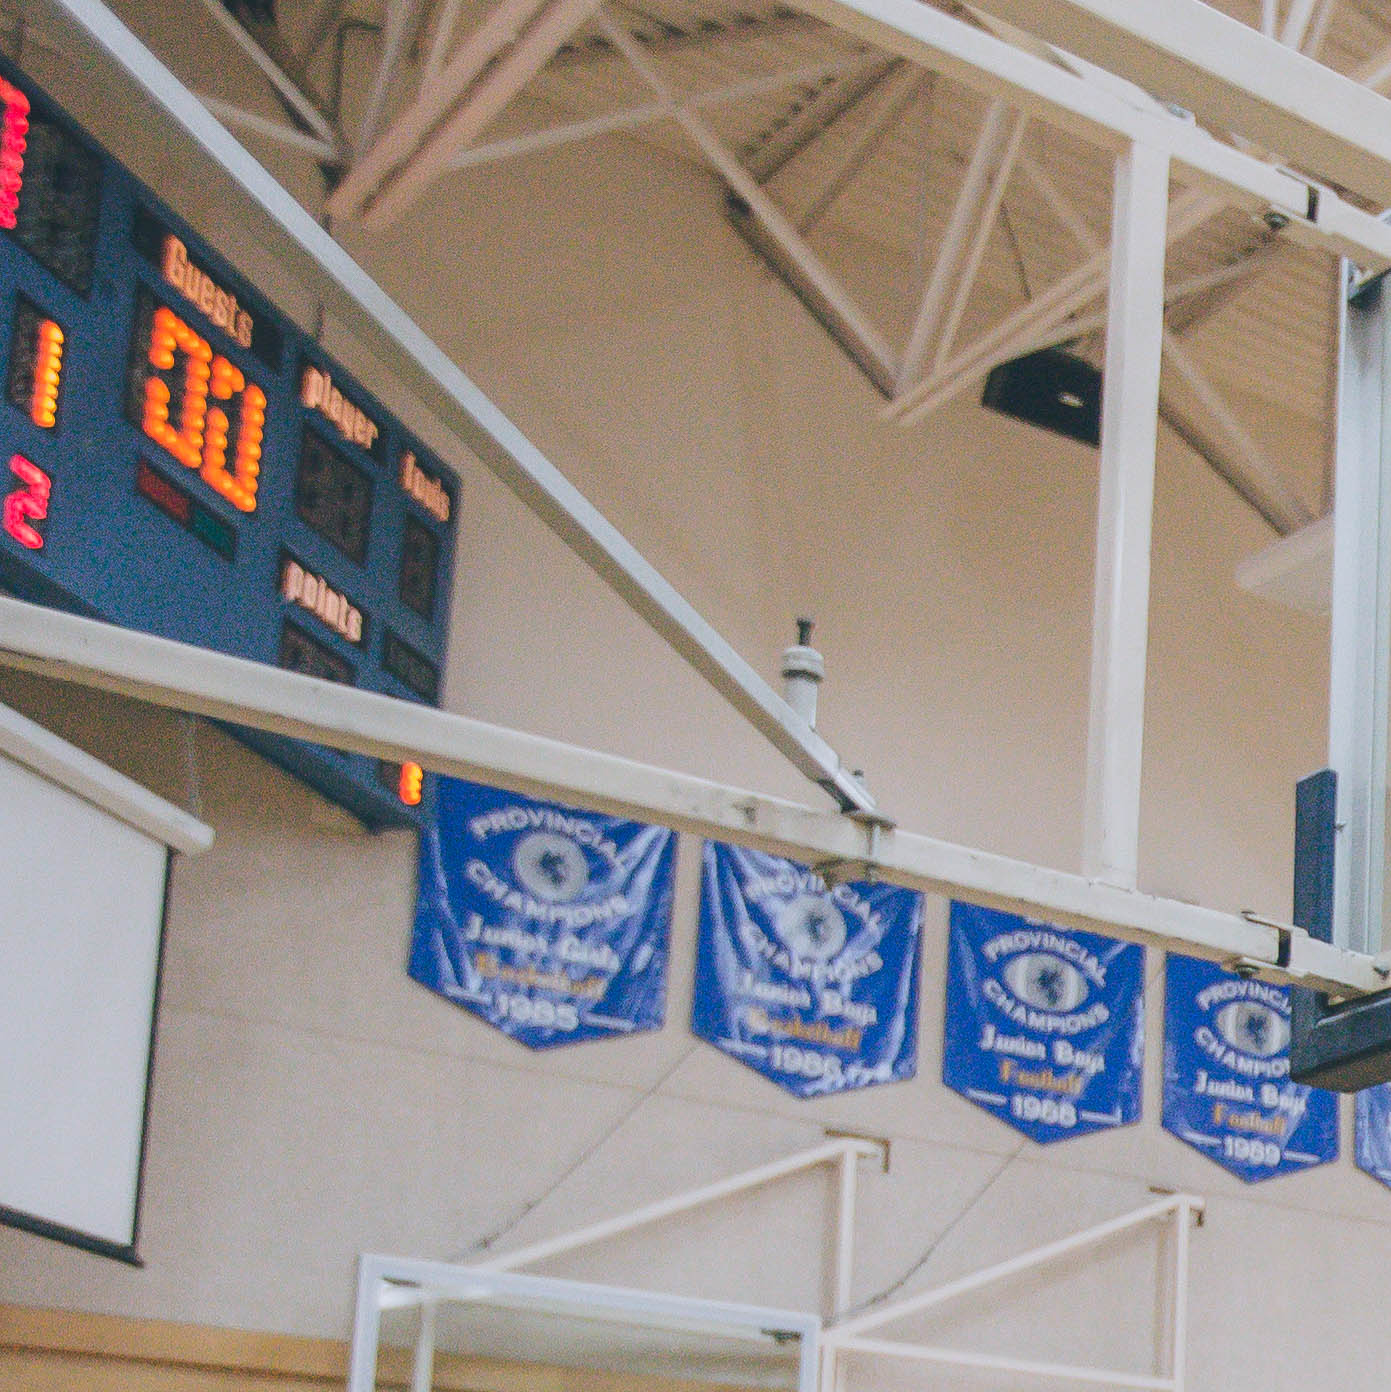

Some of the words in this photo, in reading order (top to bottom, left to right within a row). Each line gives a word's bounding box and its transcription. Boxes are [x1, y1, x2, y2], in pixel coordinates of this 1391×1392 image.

[164, 233, 254, 348] Guests
[282, 559, 363, 642] points
[466, 858, 637, 926] CHAMPIONS
[981, 930, 1109, 988] PROVINCIAL
[982, 977, 1111, 1036] CHAMPIONS
[978, 1023, 1047, 1061] Junior
[1052, 1038, 1106, 1076] Boys
[1194, 1069, 1255, 1103] Junior
[1260, 1082, 1307, 1116] Boys
